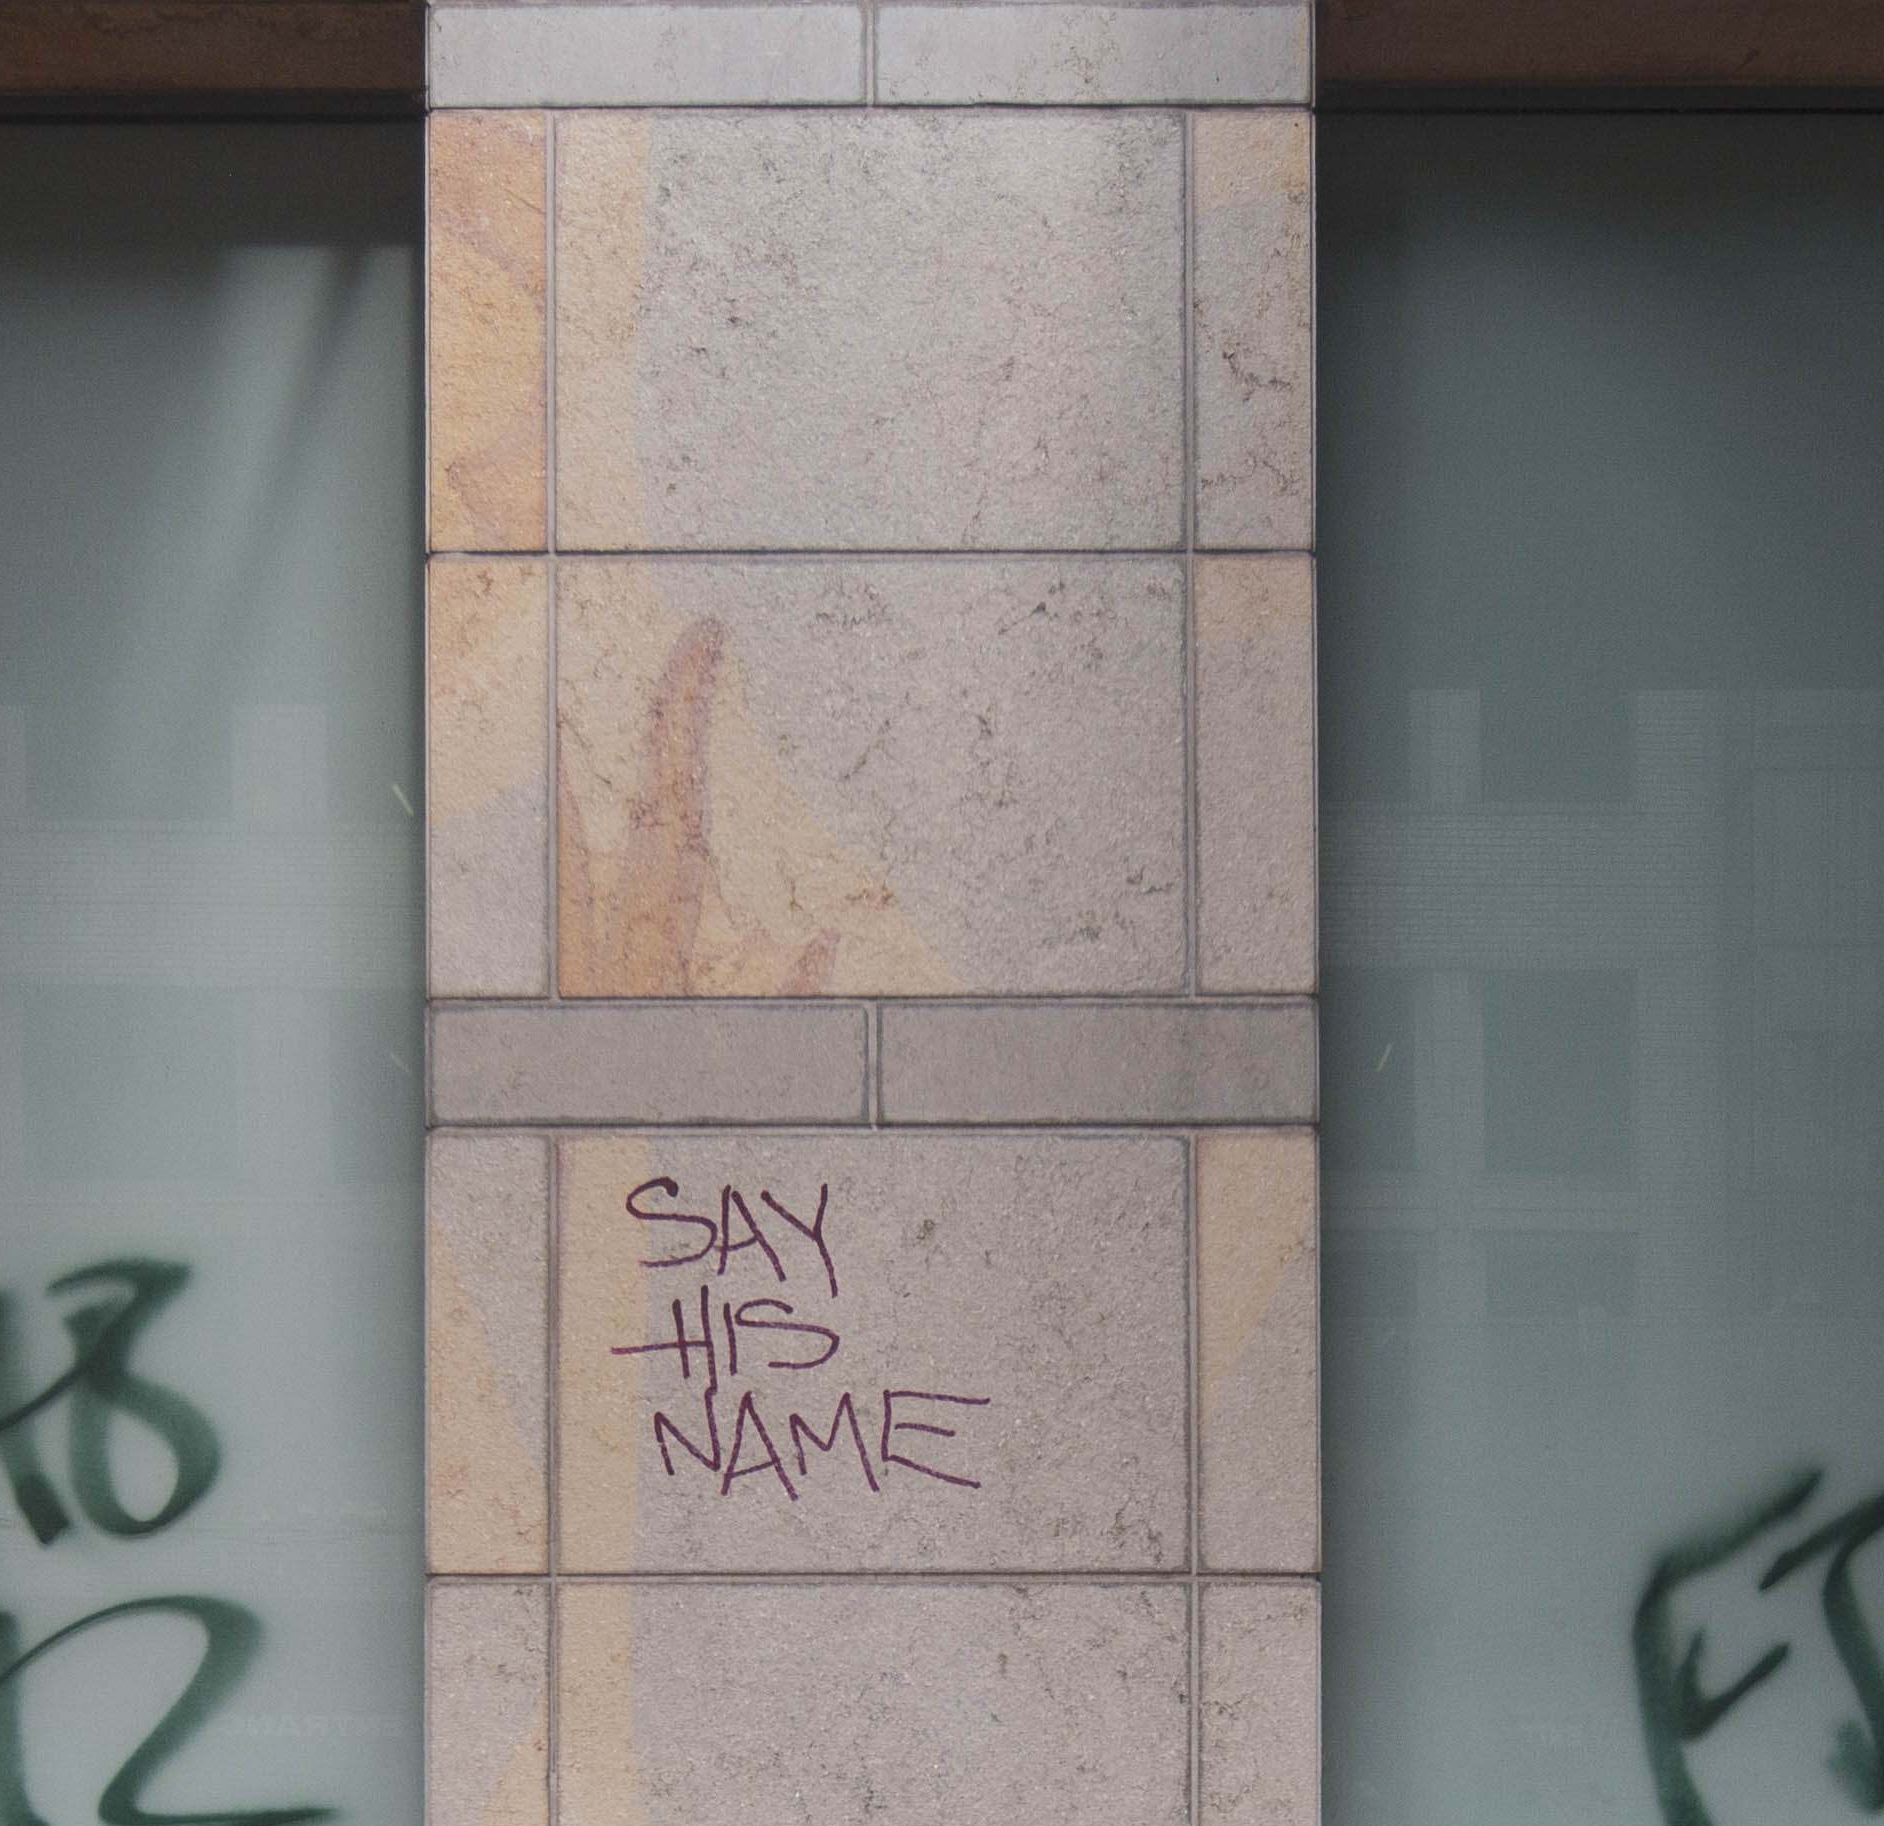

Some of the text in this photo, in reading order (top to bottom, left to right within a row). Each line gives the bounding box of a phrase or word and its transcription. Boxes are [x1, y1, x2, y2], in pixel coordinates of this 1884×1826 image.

[625, 1175, 840, 1298] SAY
[610, 1284, 840, 1392] HIS
[653, 1389, 992, 1501] NAME
